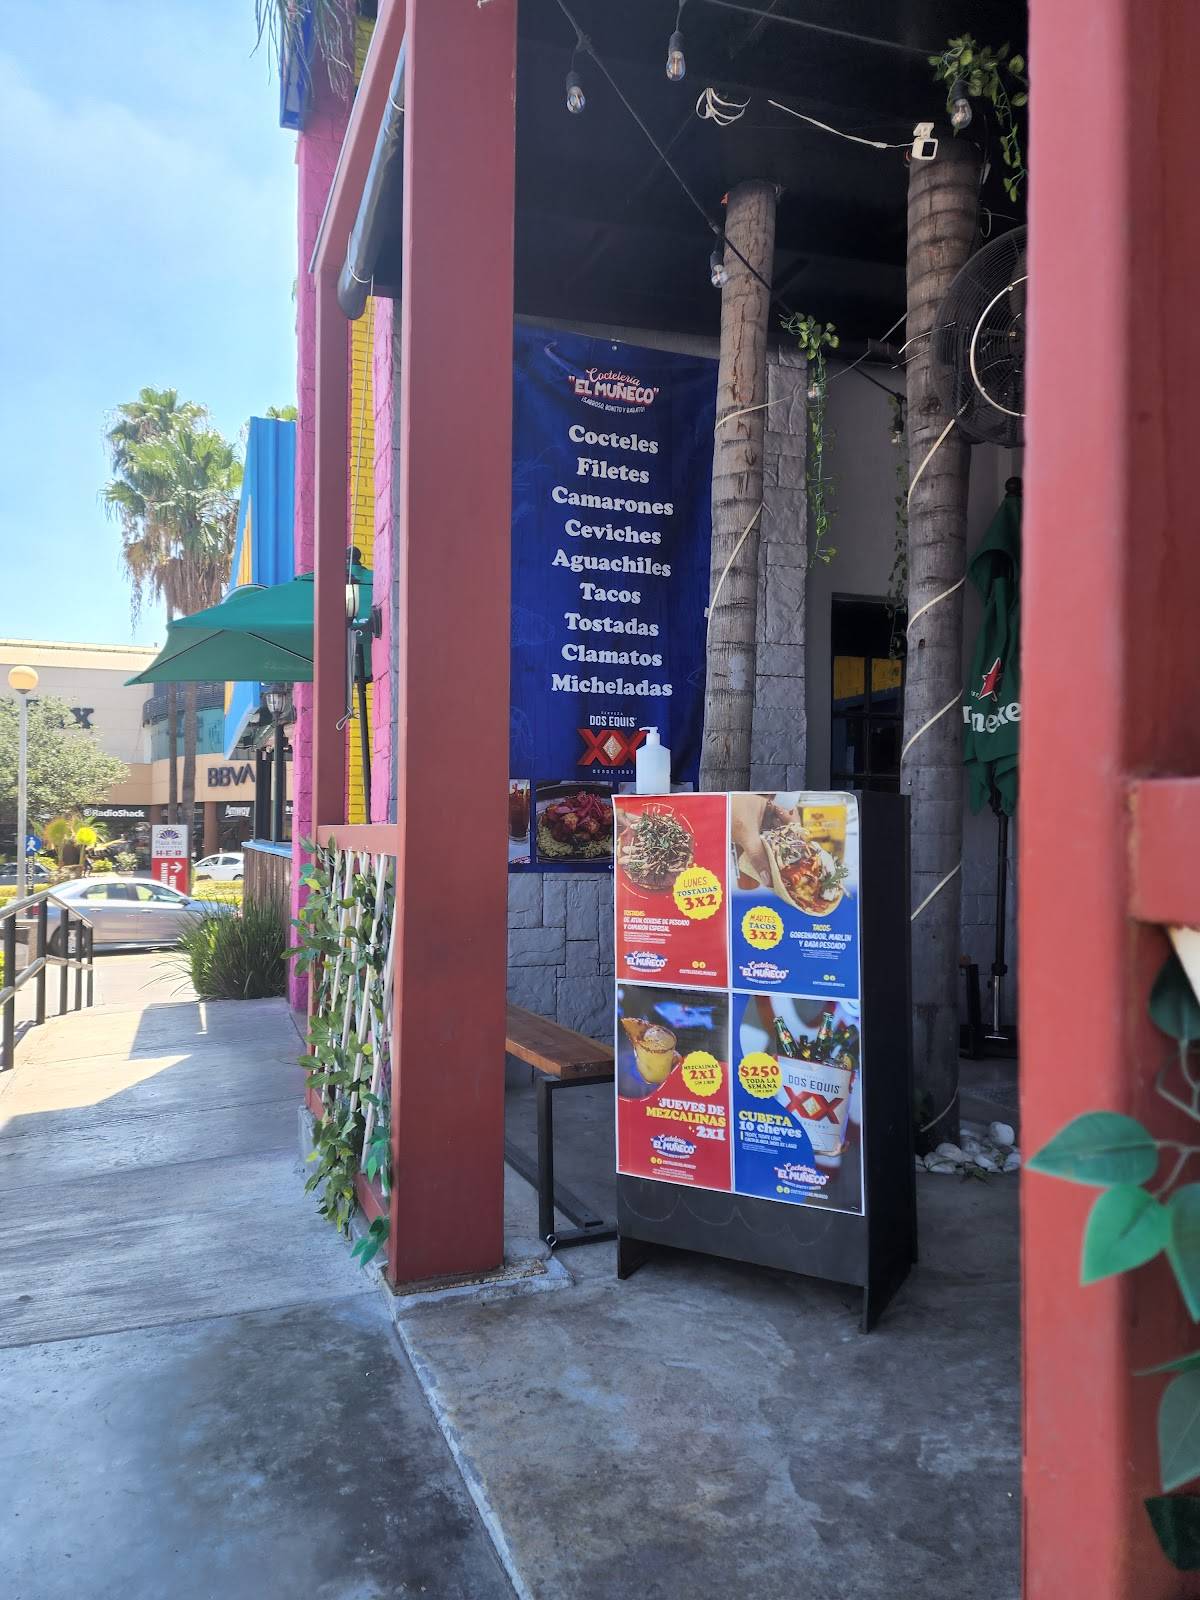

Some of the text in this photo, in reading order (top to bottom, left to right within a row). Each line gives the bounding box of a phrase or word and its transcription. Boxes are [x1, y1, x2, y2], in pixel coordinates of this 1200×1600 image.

[594, 382, 660, 405] MUÑECO"
[568, 424, 659, 455] Cocteles
[576, 457, 650, 484] Filetes
[552, 486, 674, 516] Camarones
[564, 518, 662, 545] Ceviches
[552, 549, 672, 577] Aguachiles
[579, 582, 642, 605] Tacos
[564, 612, 660, 637] Tostadas
[561, 643, 663, 667] Clamatos
[551, 673, 673, 697] Micheladas
[590, 715, 636, 728] DOS EQUIS
[208, 763, 256, 788] BBVA
[93, 808, 145, 818] RadioShack
[678, 885, 718, 897] TOSTADAS
[683, 877, 708, 888] LUNES
[750, 922, 777, 930] TACOS
[740, 1065, 780, 1078] $250
[788, 1074, 806, 1088] DOS
[810, 1080, 840, 1094] EQUIS
[646, 1106, 726, 1128] MEZCALINAS
[658, 1098, 725, 1116] JUEVES DE
[738, 1110, 793, 1128] CUBETA
[738, 1120, 755, 1132] 10
[756, 1122, 802, 1138] cheves
